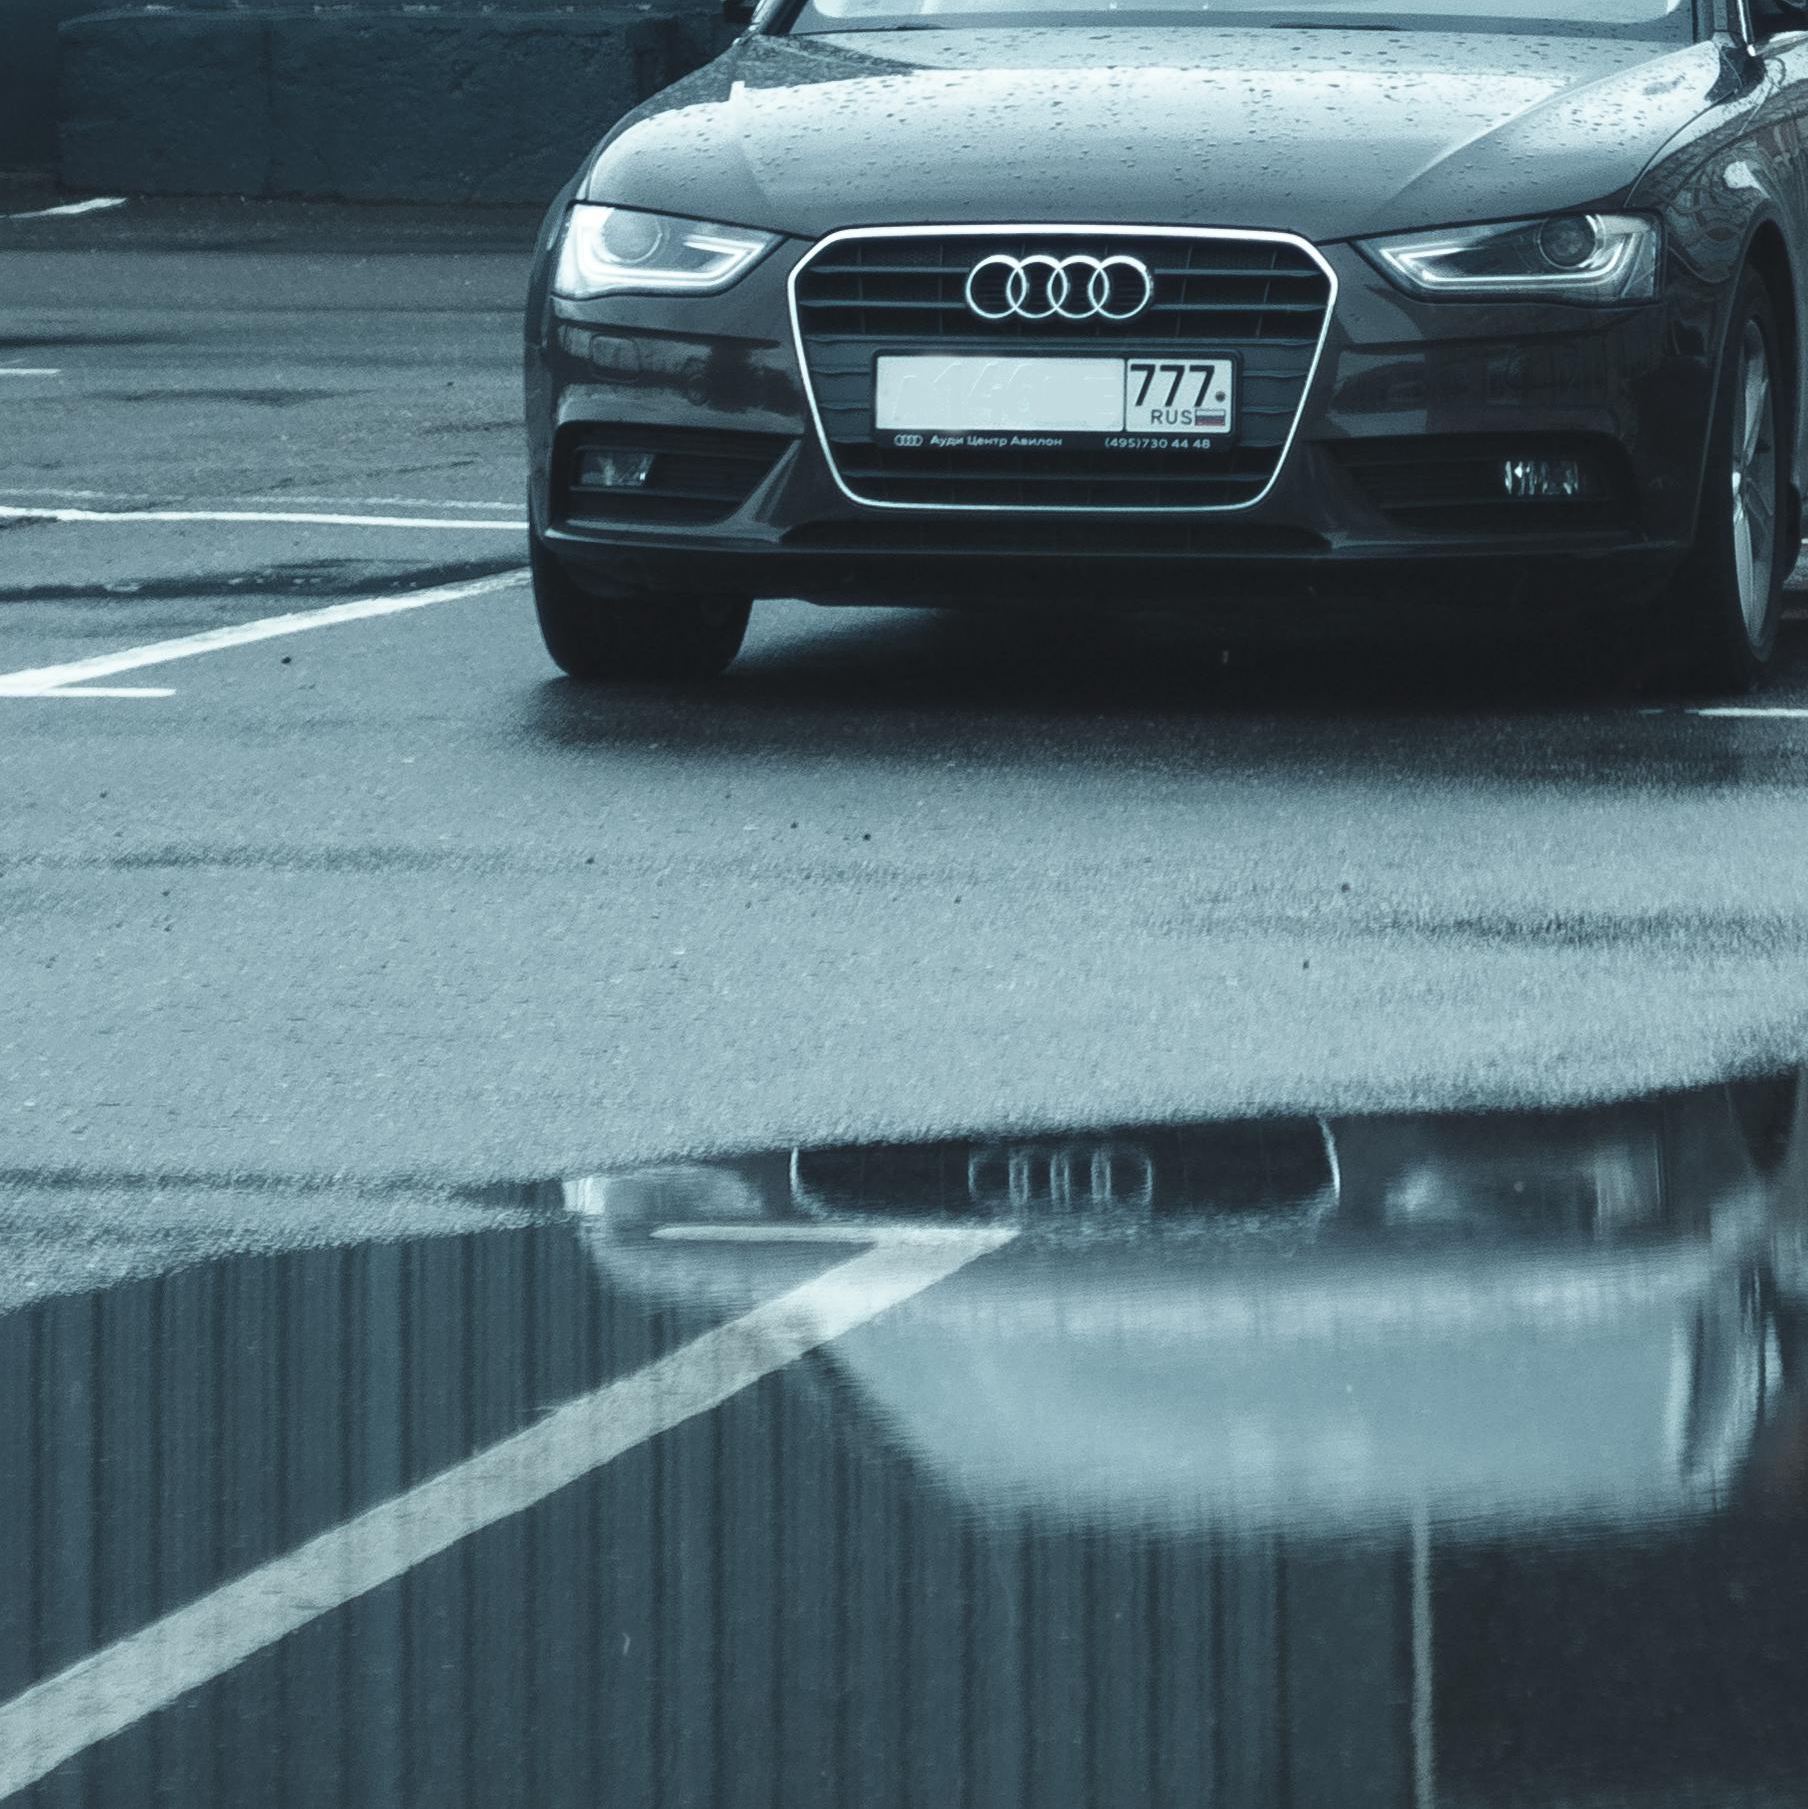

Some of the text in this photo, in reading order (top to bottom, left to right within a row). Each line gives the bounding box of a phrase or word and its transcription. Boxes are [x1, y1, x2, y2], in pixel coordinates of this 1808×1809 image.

[1130, 364, 1215, 407] 777
[1151, 409, 1192, 425] RUS
[930, 434, 1063, 447] Ауди Центр Авилон
[1171, 438, 1189, 449] 44
[1193, 438, 1211, 449] 48
